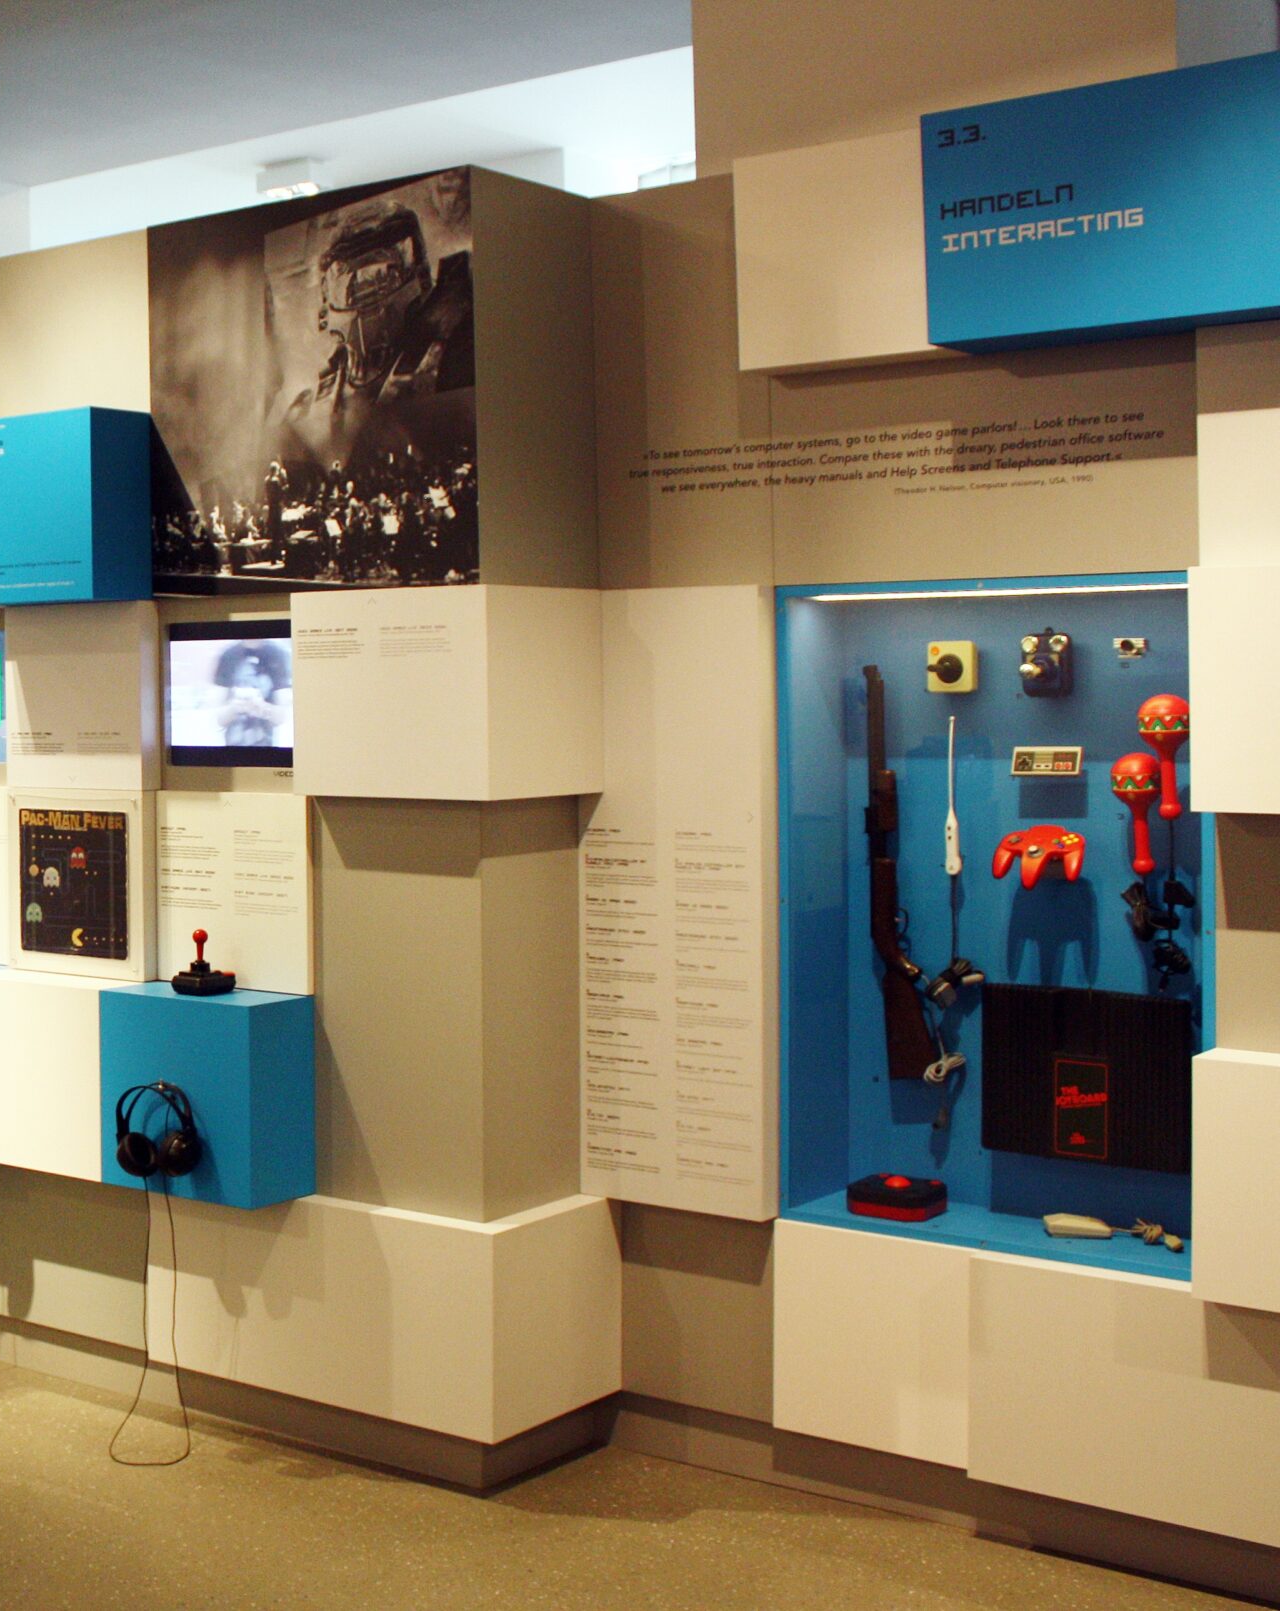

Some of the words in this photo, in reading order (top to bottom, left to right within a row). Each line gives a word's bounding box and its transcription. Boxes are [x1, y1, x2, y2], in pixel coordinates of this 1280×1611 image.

[937, 124, 986, 148] 3.3.
[940, 183, 1074, 220] HANDELN
[942, 207, 1144, 253] INTERACTING
[629, 468, 650, 479] true
[651, 461, 730, 478] responsiveness,
[732, 460, 754, 471] true
[756, 456, 816, 469] interaction.
[819, 453, 869, 466] Compare
[872, 450, 903, 462] these
[906, 446, 930, 459] with
[934, 444, 953, 456] the
[956, 441, 997, 456] dreary,
[1000, 437, 1066, 453] pedestrian
[1069, 432, 1104, 446] office
[1108, 428, 1165, 443] software
[663, 449, 681, 460] see
[743, 440, 794, 454] computer
[797, 437, 843, 450] systems,
[846, 436, 862, 448] go
[864, 434, 876, 443] to
[879, 431, 898, 442] the
[901, 427, 932, 441] video
[936, 427, 968, 441] game
[1033, 417, 1063, 431] Look
[1067, 414, 1100, 427] there
[1104, 413, 1118, 424] to
[1122, 411, 1145, 423] see
[661, 484, 677, 493] we
[679, 483, 696, 492] see
[698, 477, 761, 492] everywhere,
[763, 475, 781, 487] the
[784, 473, 816, 487] heavy
[819, 470, 863, 483] manuals
[866, 468, 887, 480] and
[891, 466, 917, 480] Help
[921, 463, 966, 476] Screens
[969, 460, 991, 472] and
[995, 456, 1057, 471] Telephone
